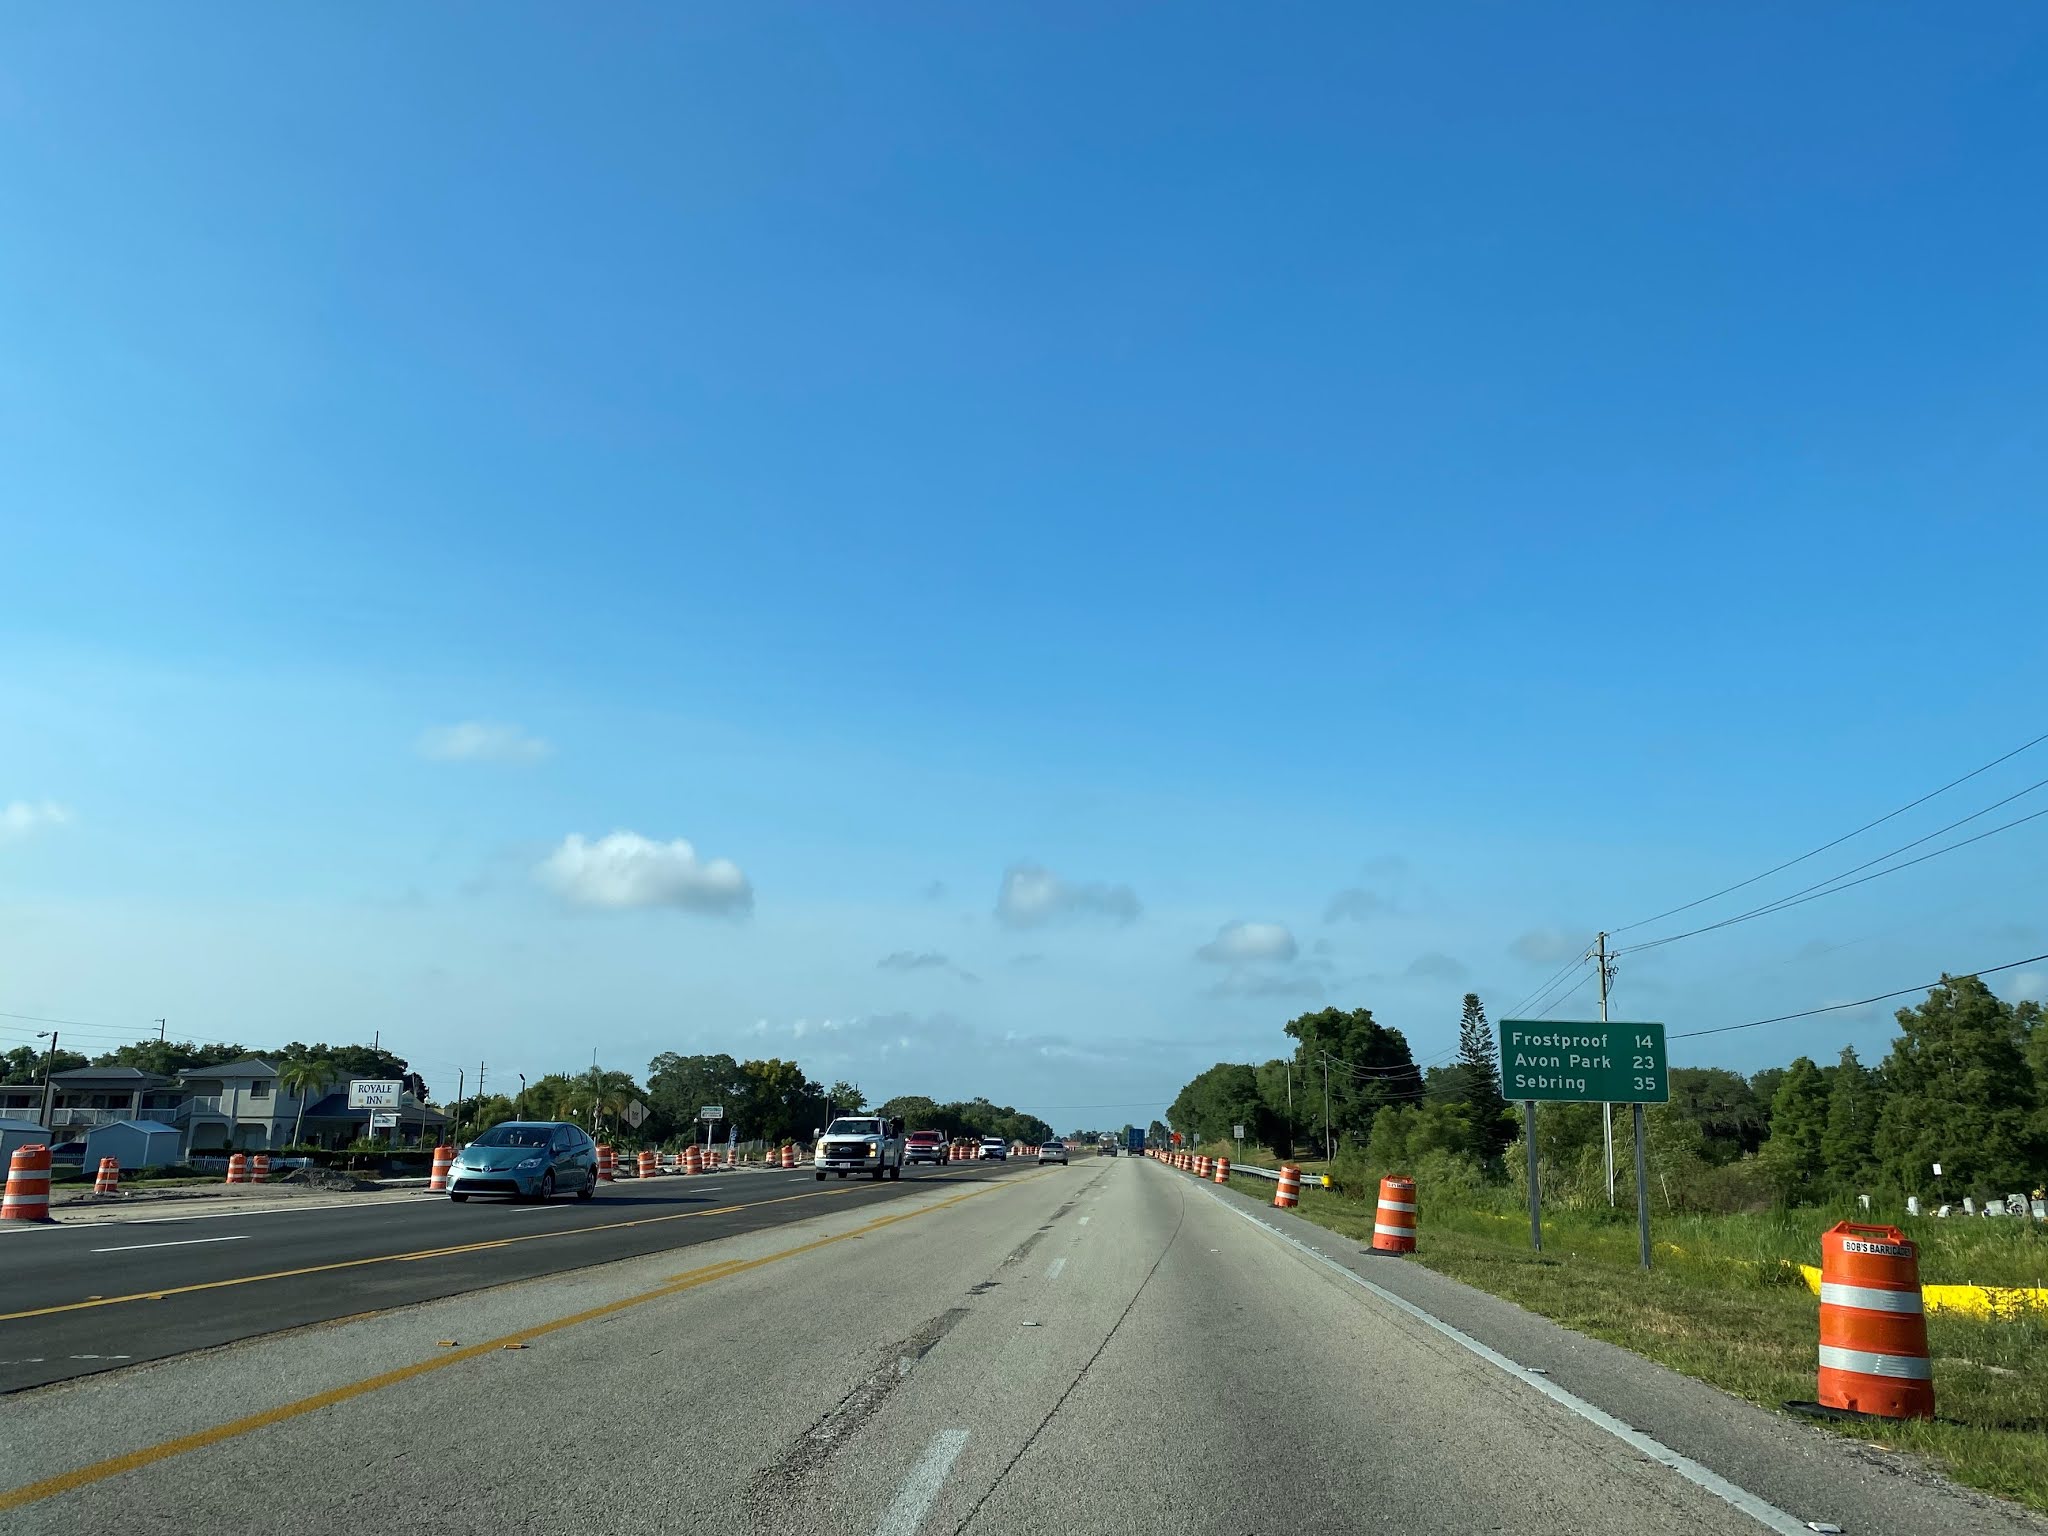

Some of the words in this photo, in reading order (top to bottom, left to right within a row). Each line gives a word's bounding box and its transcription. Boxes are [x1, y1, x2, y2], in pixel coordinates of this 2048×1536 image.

[1512, 1032, 1608, 1050] Frostproof
[1634, 1034, 1654, 1049] 14
[1514, 1053, 1560, 1068] Avon
[1569, 1054, 1611, 1068] Park
[1632, 1055, 1655, 1070] 23
[358, 1084, 392, 1094] ROYALE
[1515, 1074, 1586, 1093] Sebring
[1633, 1076, 1656, 1091] 35
[366, 1095, 383, 1105] INN
[1846, 1241, 1868, 1252] BOB'S
